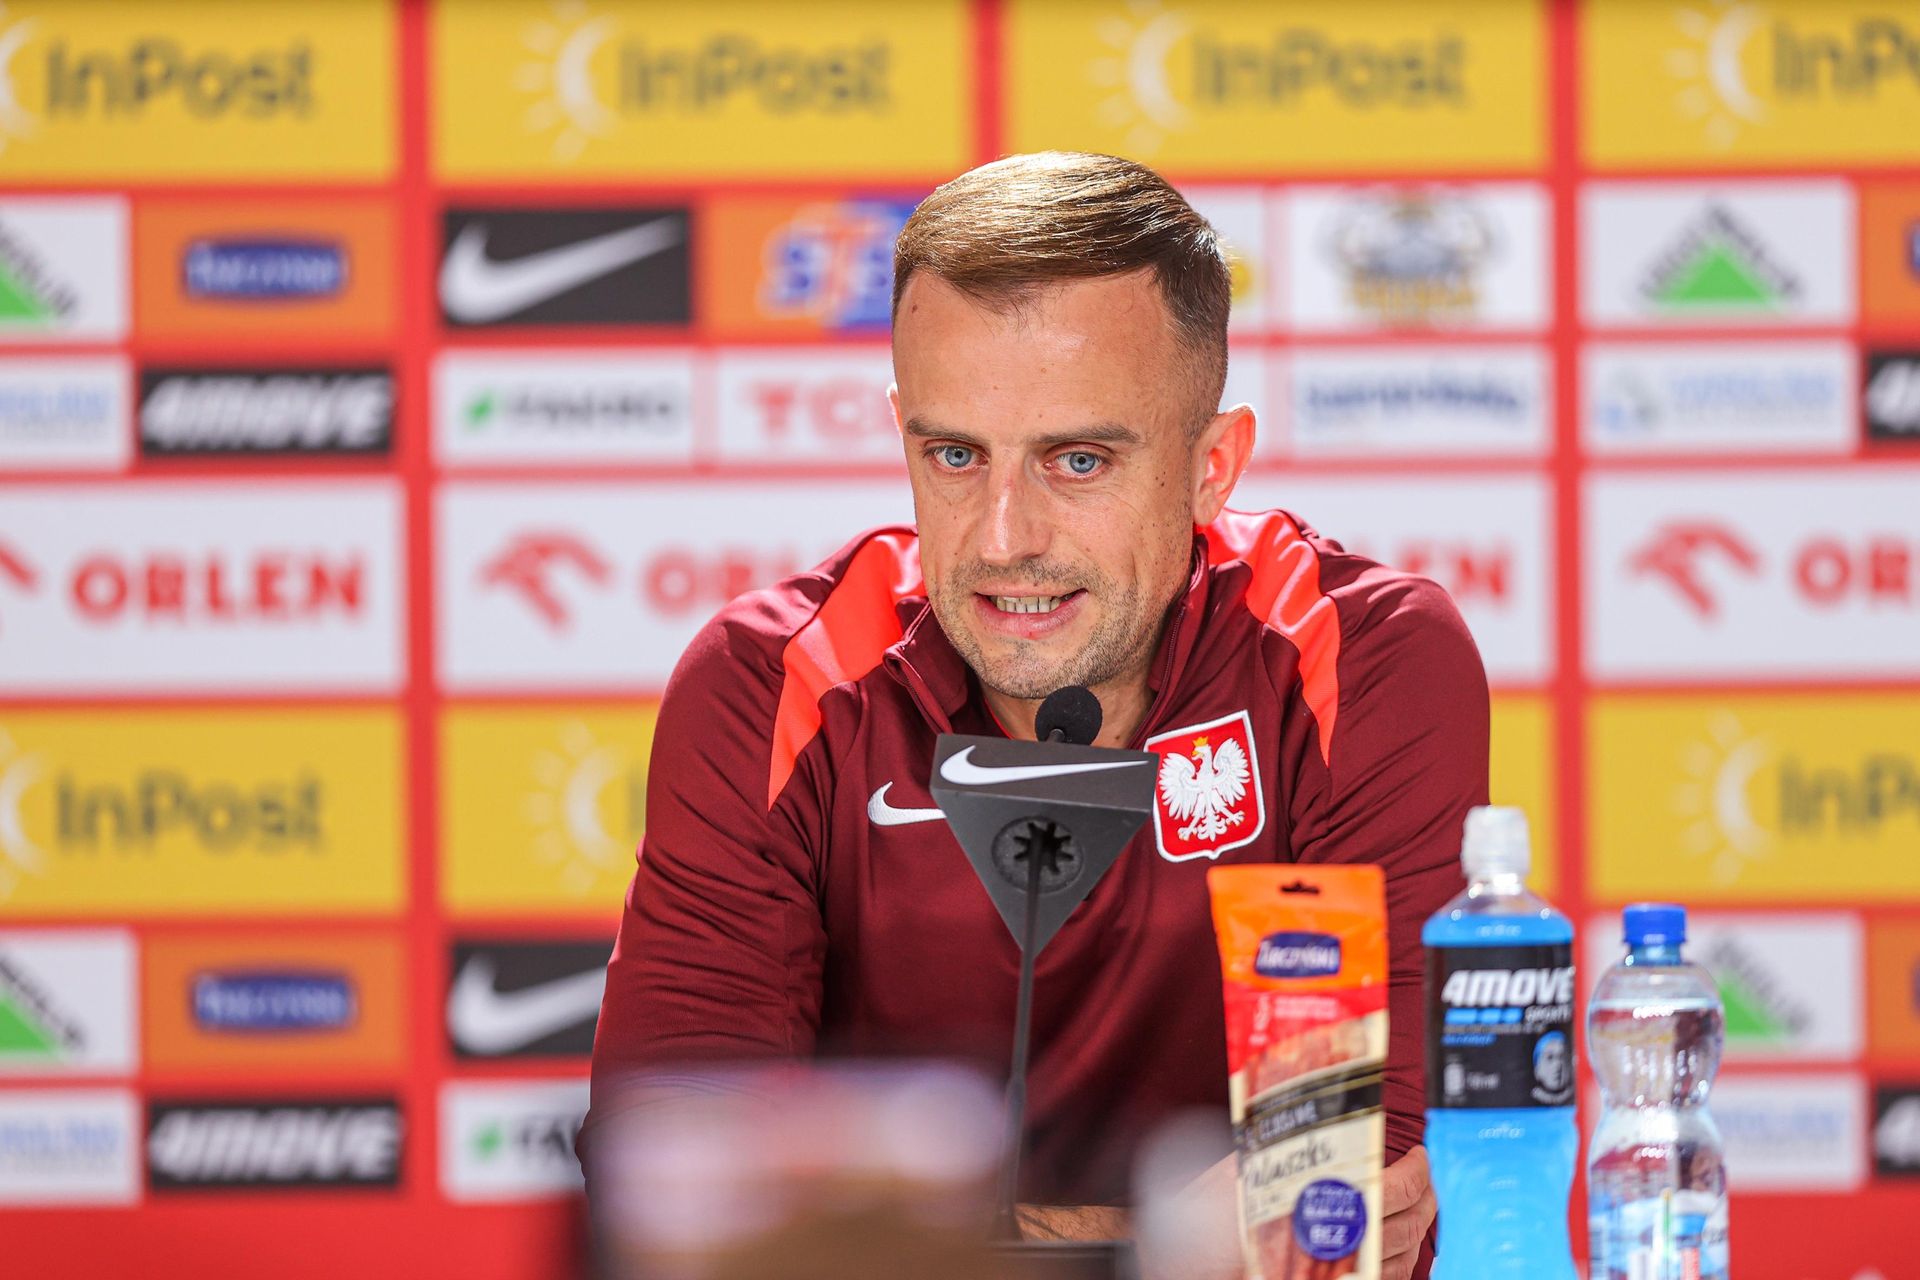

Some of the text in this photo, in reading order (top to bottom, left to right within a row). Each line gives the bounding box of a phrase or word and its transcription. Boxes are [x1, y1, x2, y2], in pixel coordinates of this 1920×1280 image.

[46, 39, 313, 120] InPost
[618, 36, 892, 112] InPost
[1191, 28, 1466, 107] InPost
[72, 550, 364, 622] ORLEN
[57, 768, 324, 852] InPost
[1440, 967, 1575, 1006] 4MOVE
